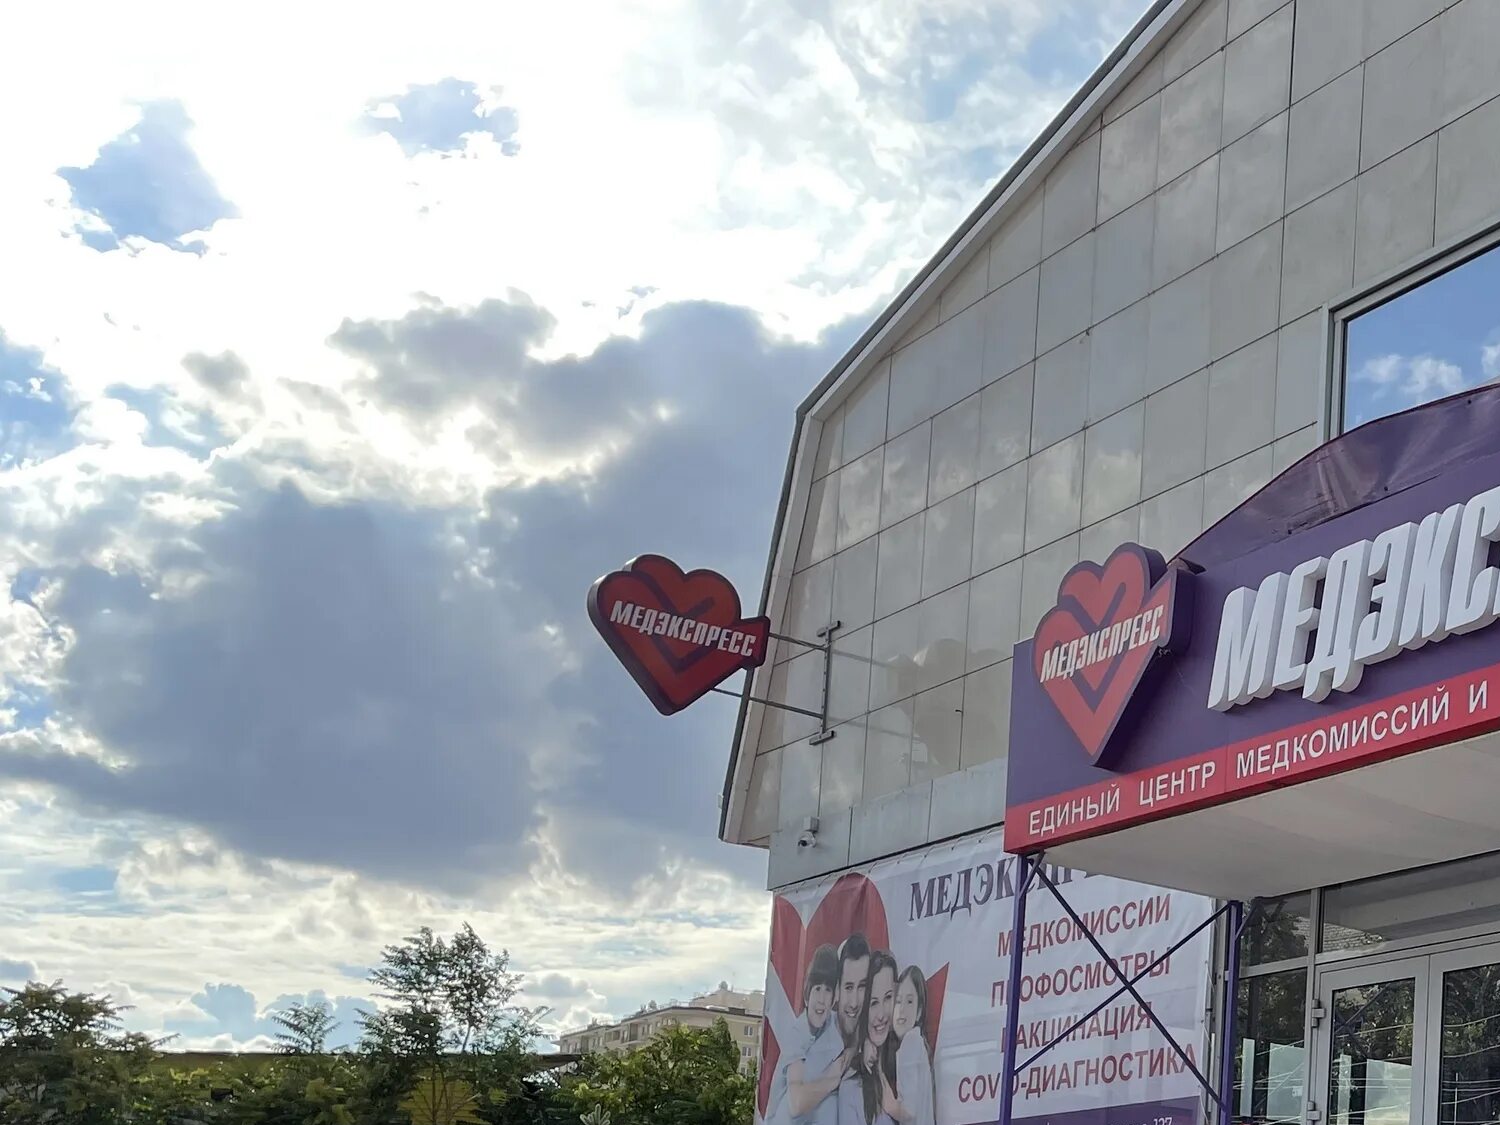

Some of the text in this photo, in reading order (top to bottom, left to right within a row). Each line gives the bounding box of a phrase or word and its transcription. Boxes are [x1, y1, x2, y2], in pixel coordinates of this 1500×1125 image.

[609, 600, 757, 657] МЕДЭКСПРЕСС
[1040, 605, 1164, 683] МЕДЭКСПРЕСС
[1029, 784, 1120, 836] ЕДИНЫЙ
[1139, 761, 1216, 807] ЦЕНТР
[1236, 684, 1450, 779] МЕДКОМИССИЙ
[1468, 680, 1488, 713] И
[997, 894, 1170, 957] МДКОМИССИИ
[991, 946, 1170, 1008] ПОФОСМОТРЫ
